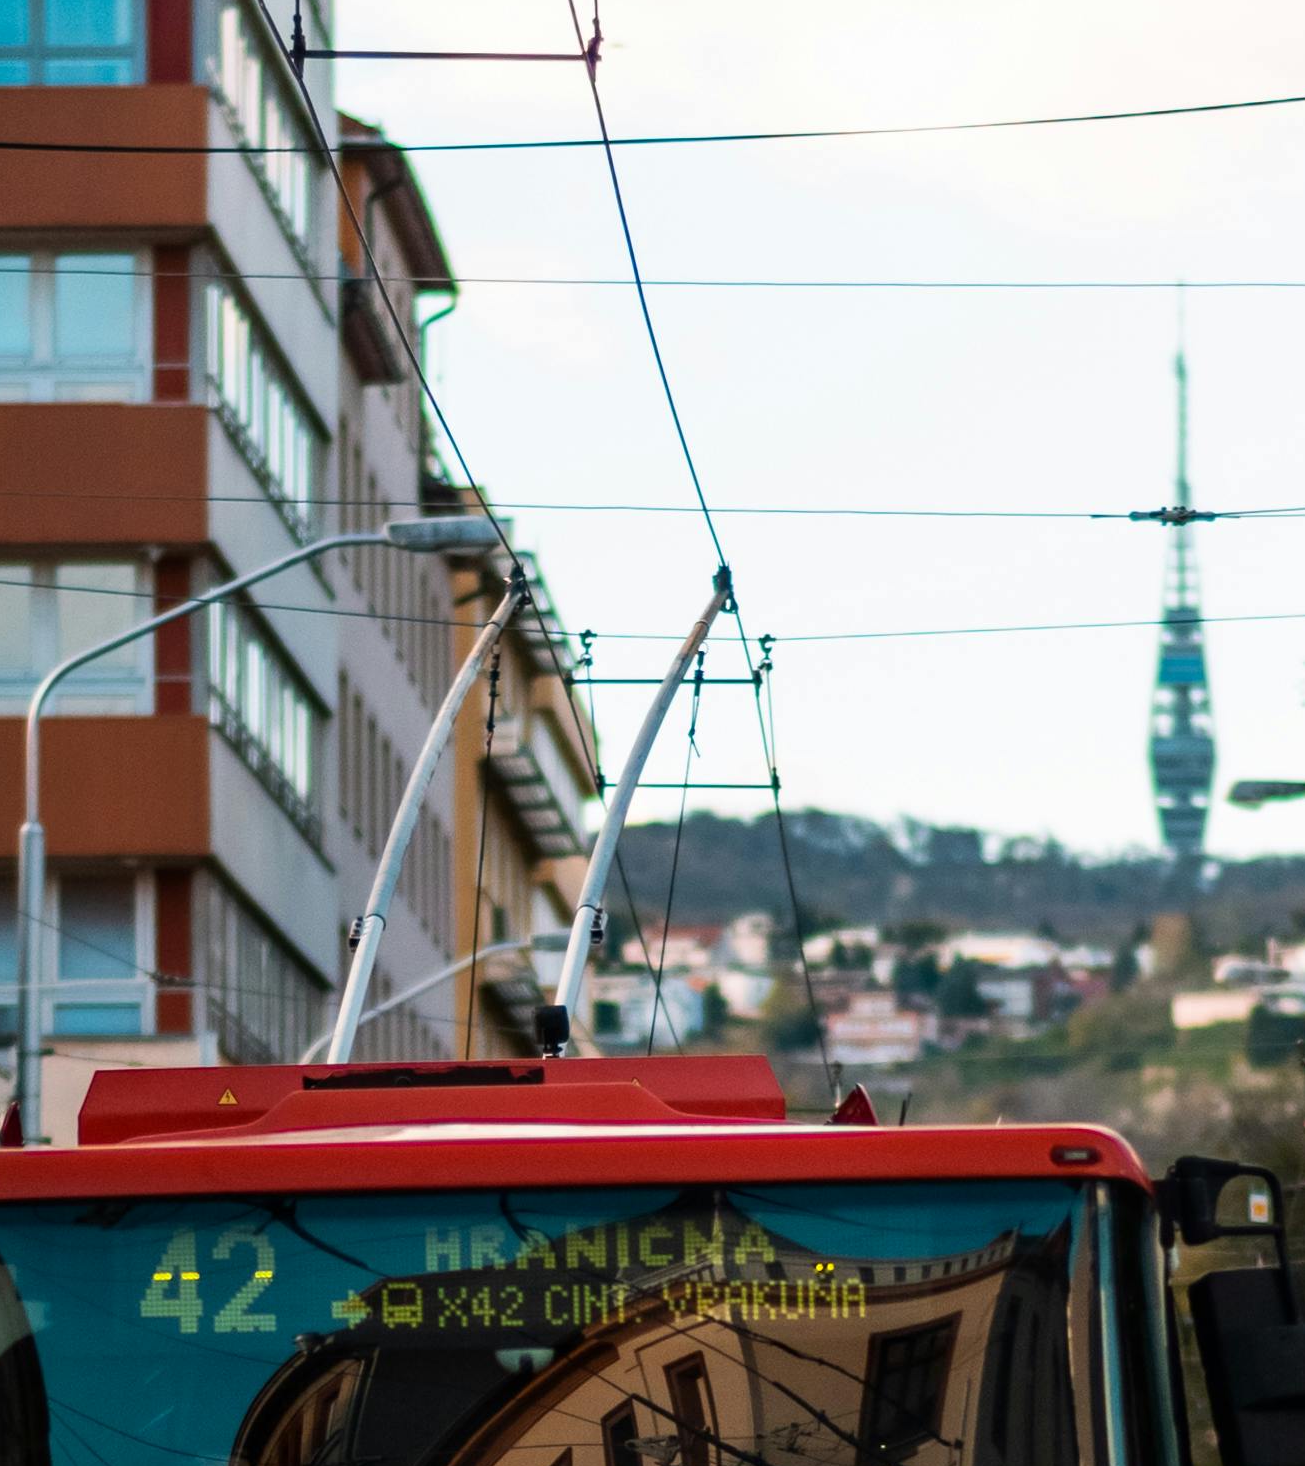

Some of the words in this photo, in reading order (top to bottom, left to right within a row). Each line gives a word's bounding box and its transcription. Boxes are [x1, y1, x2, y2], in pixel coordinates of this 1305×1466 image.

[139, 1221, 278, 1335] 42
[438, 1286, 525, 1328] X42
[544, 1283, 643, 1326] CINT.
